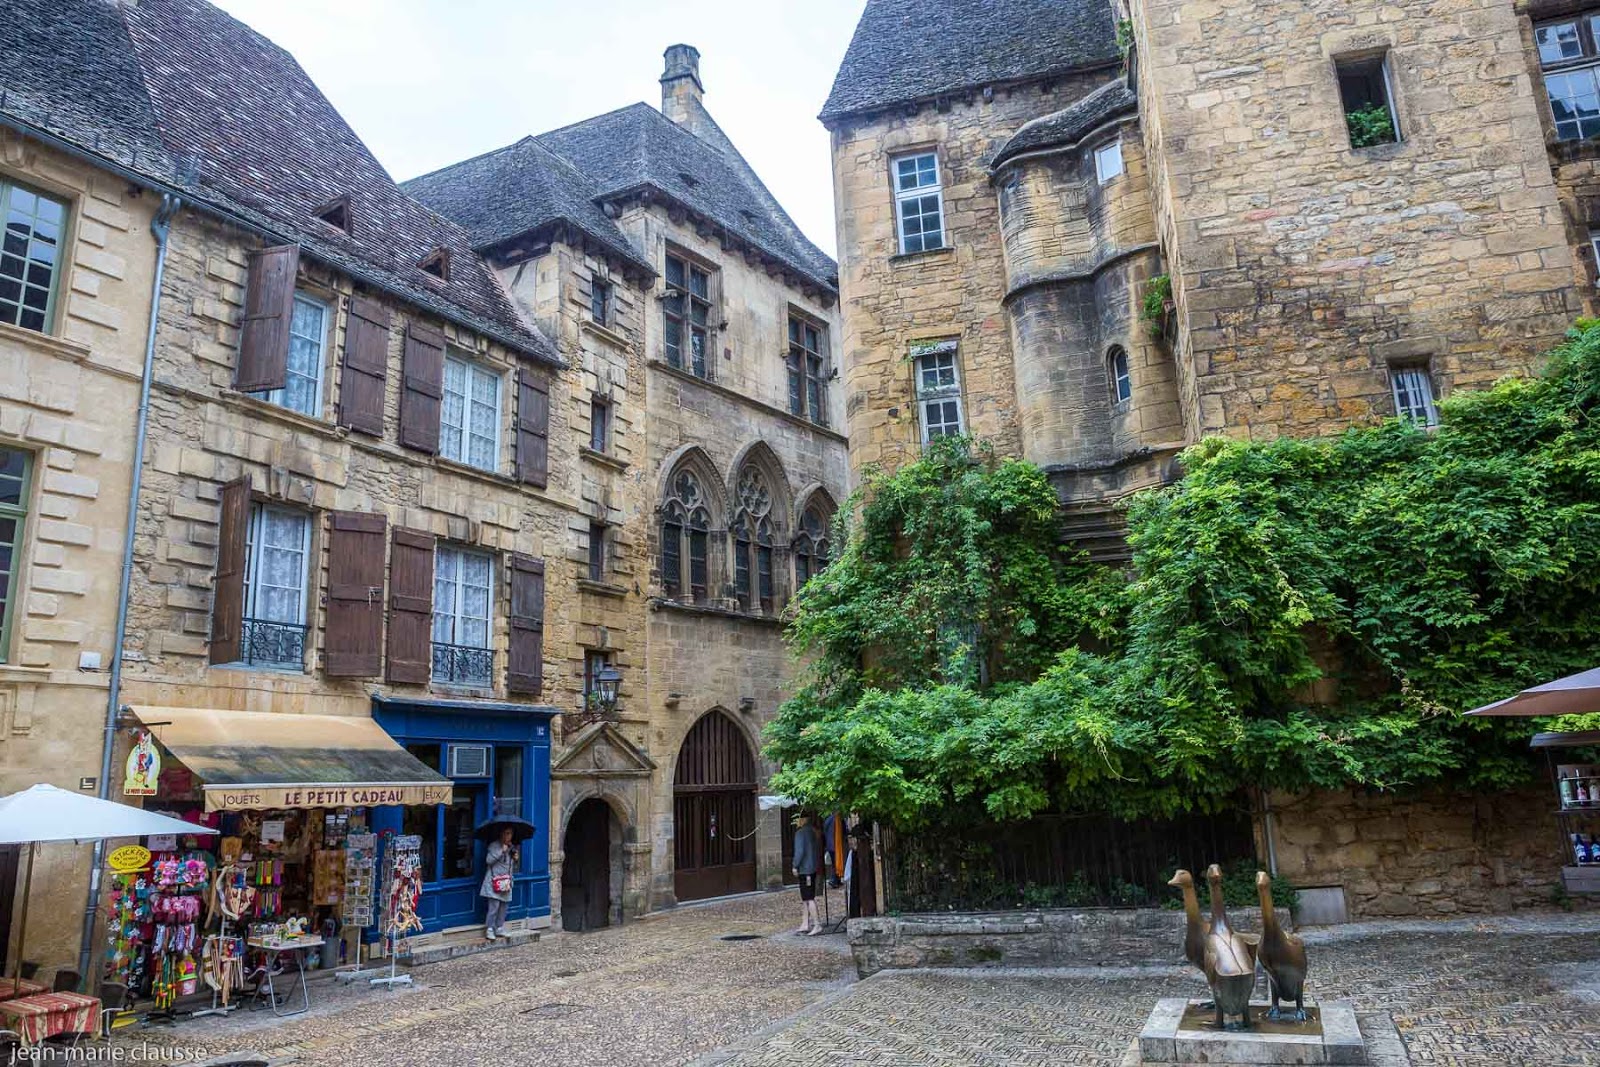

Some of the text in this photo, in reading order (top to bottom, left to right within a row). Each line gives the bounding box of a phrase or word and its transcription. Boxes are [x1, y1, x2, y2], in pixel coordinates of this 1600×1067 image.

[222, 793, 261, 808] JOUETS
[284, 789, 404, 805] LE PETIT CADEAU
[422, 788, 442, 803] JEUX
[113, 848, 148, 862] STICKERS
